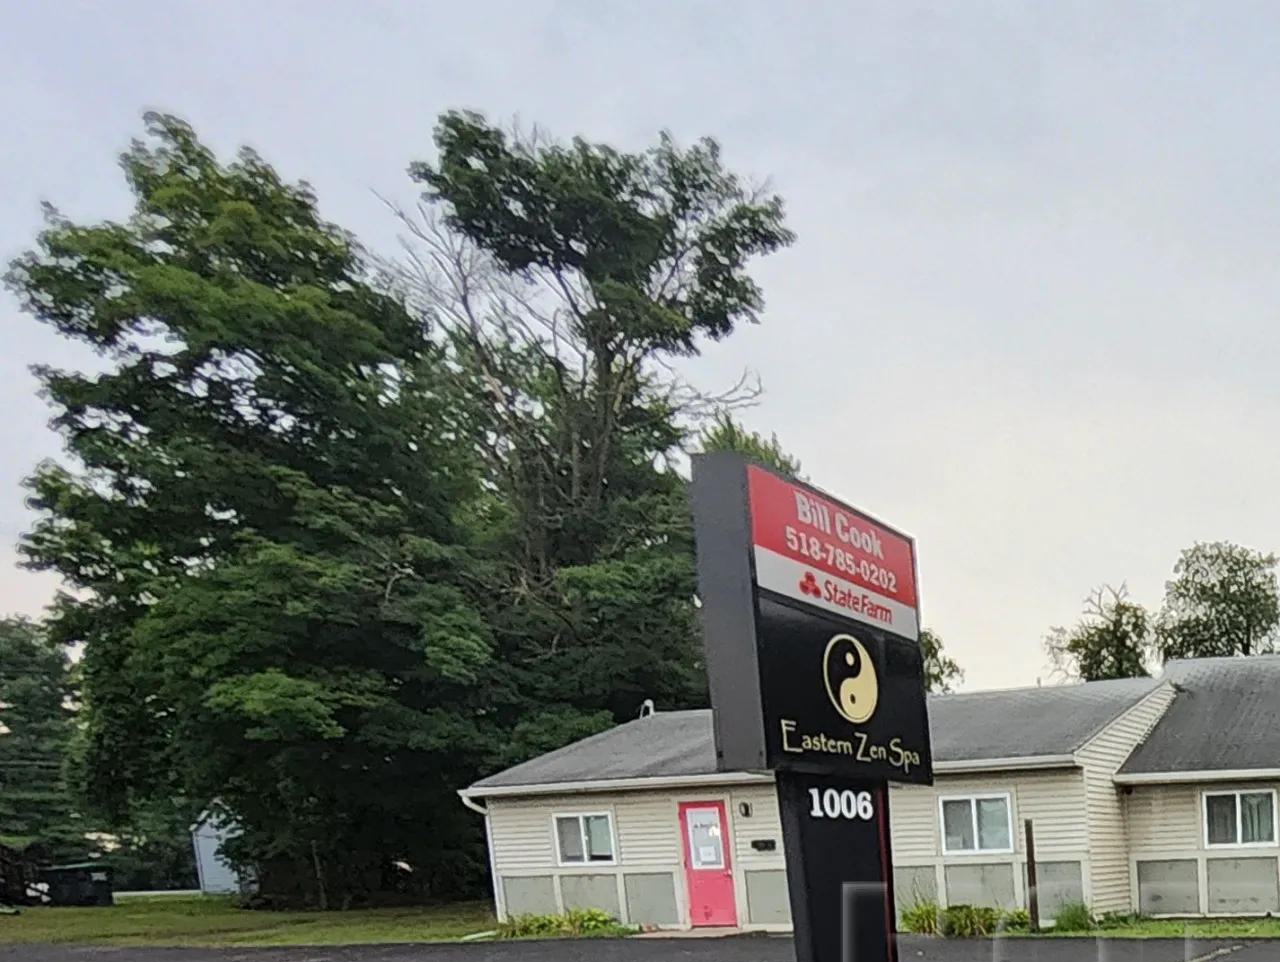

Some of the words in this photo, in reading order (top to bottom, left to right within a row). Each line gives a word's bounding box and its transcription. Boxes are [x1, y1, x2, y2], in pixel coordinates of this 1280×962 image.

[795, 491, 831, 534] Bill
[834, 510, 884, 560] Cook
[784, 526, 897, 593] 518-785-0202
[780, 719, 853, 756] Eastern
[855, 733, 887, 762] Zen
[889, 738, 921, 774] Spa
[808, 788, 874, 820] 1006
